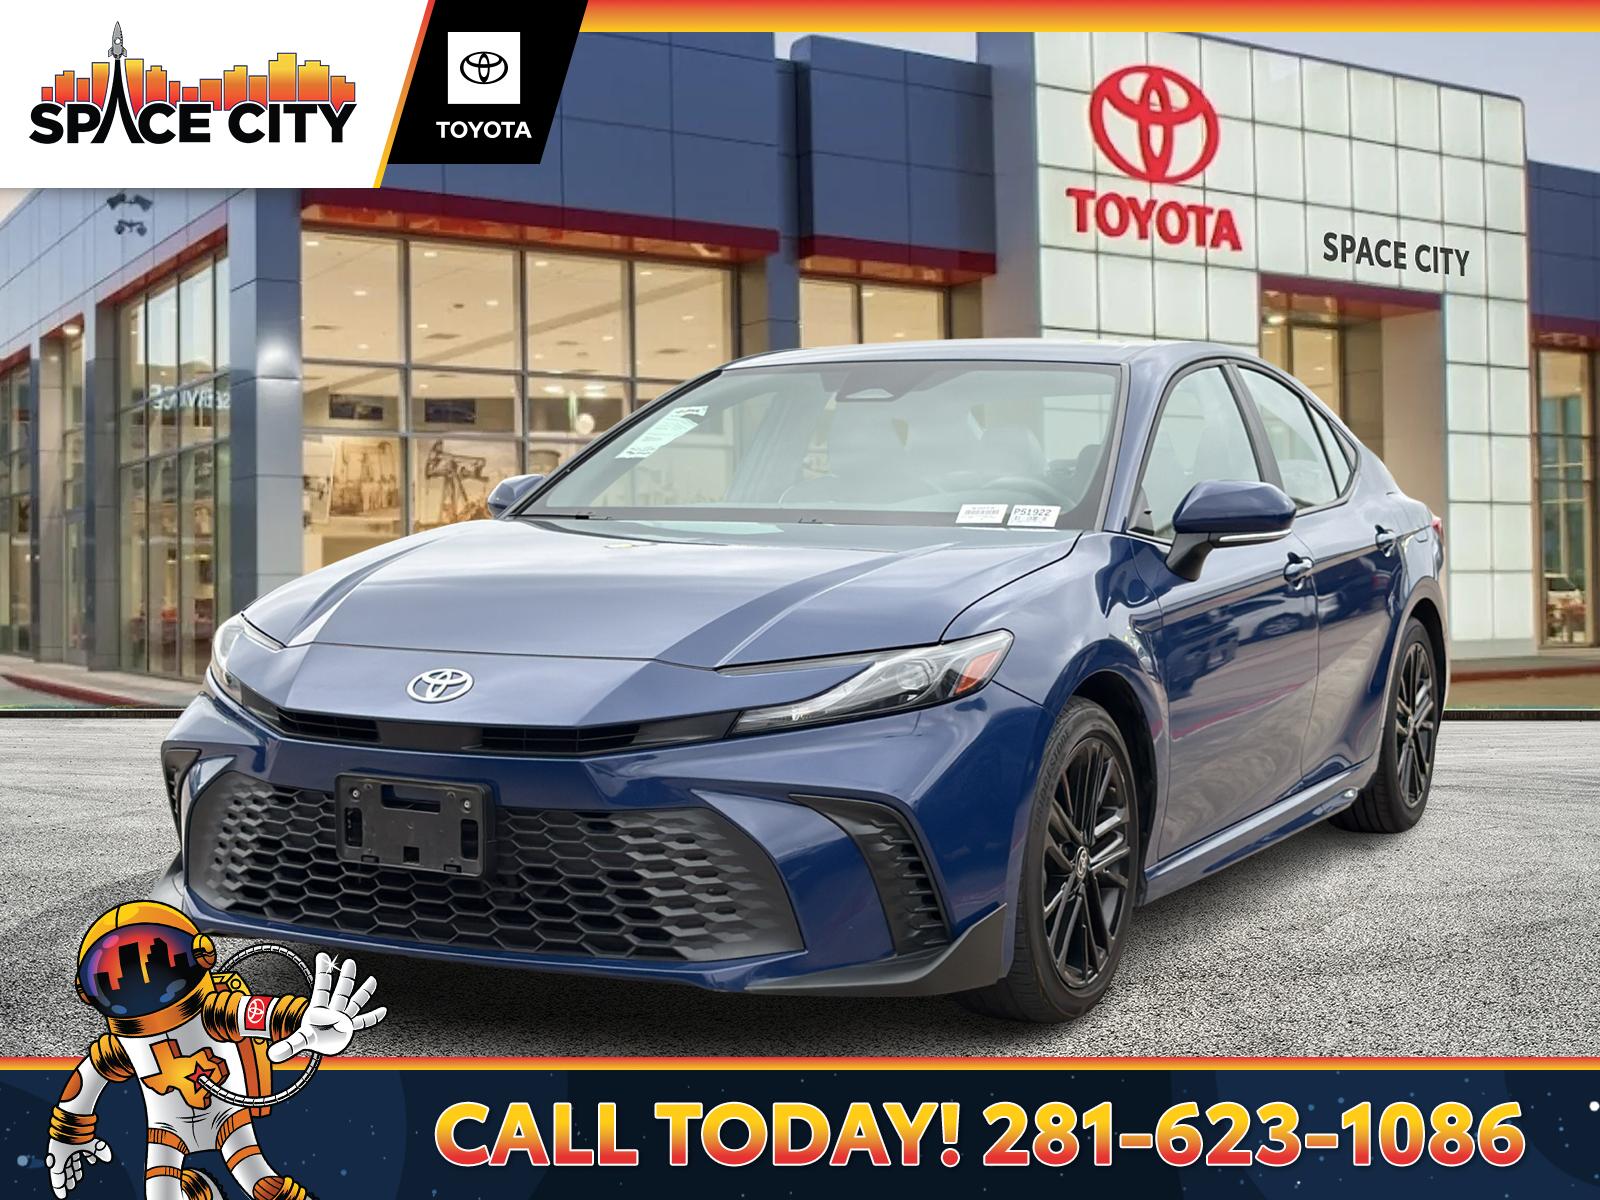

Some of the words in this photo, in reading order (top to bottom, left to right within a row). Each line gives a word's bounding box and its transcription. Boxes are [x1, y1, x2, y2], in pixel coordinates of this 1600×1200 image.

[1066, 188, 1242, 251] TOYOTA
[1323, 232, 1407, 270] SPACE
[1415, 244, 1470, 276] CITY
